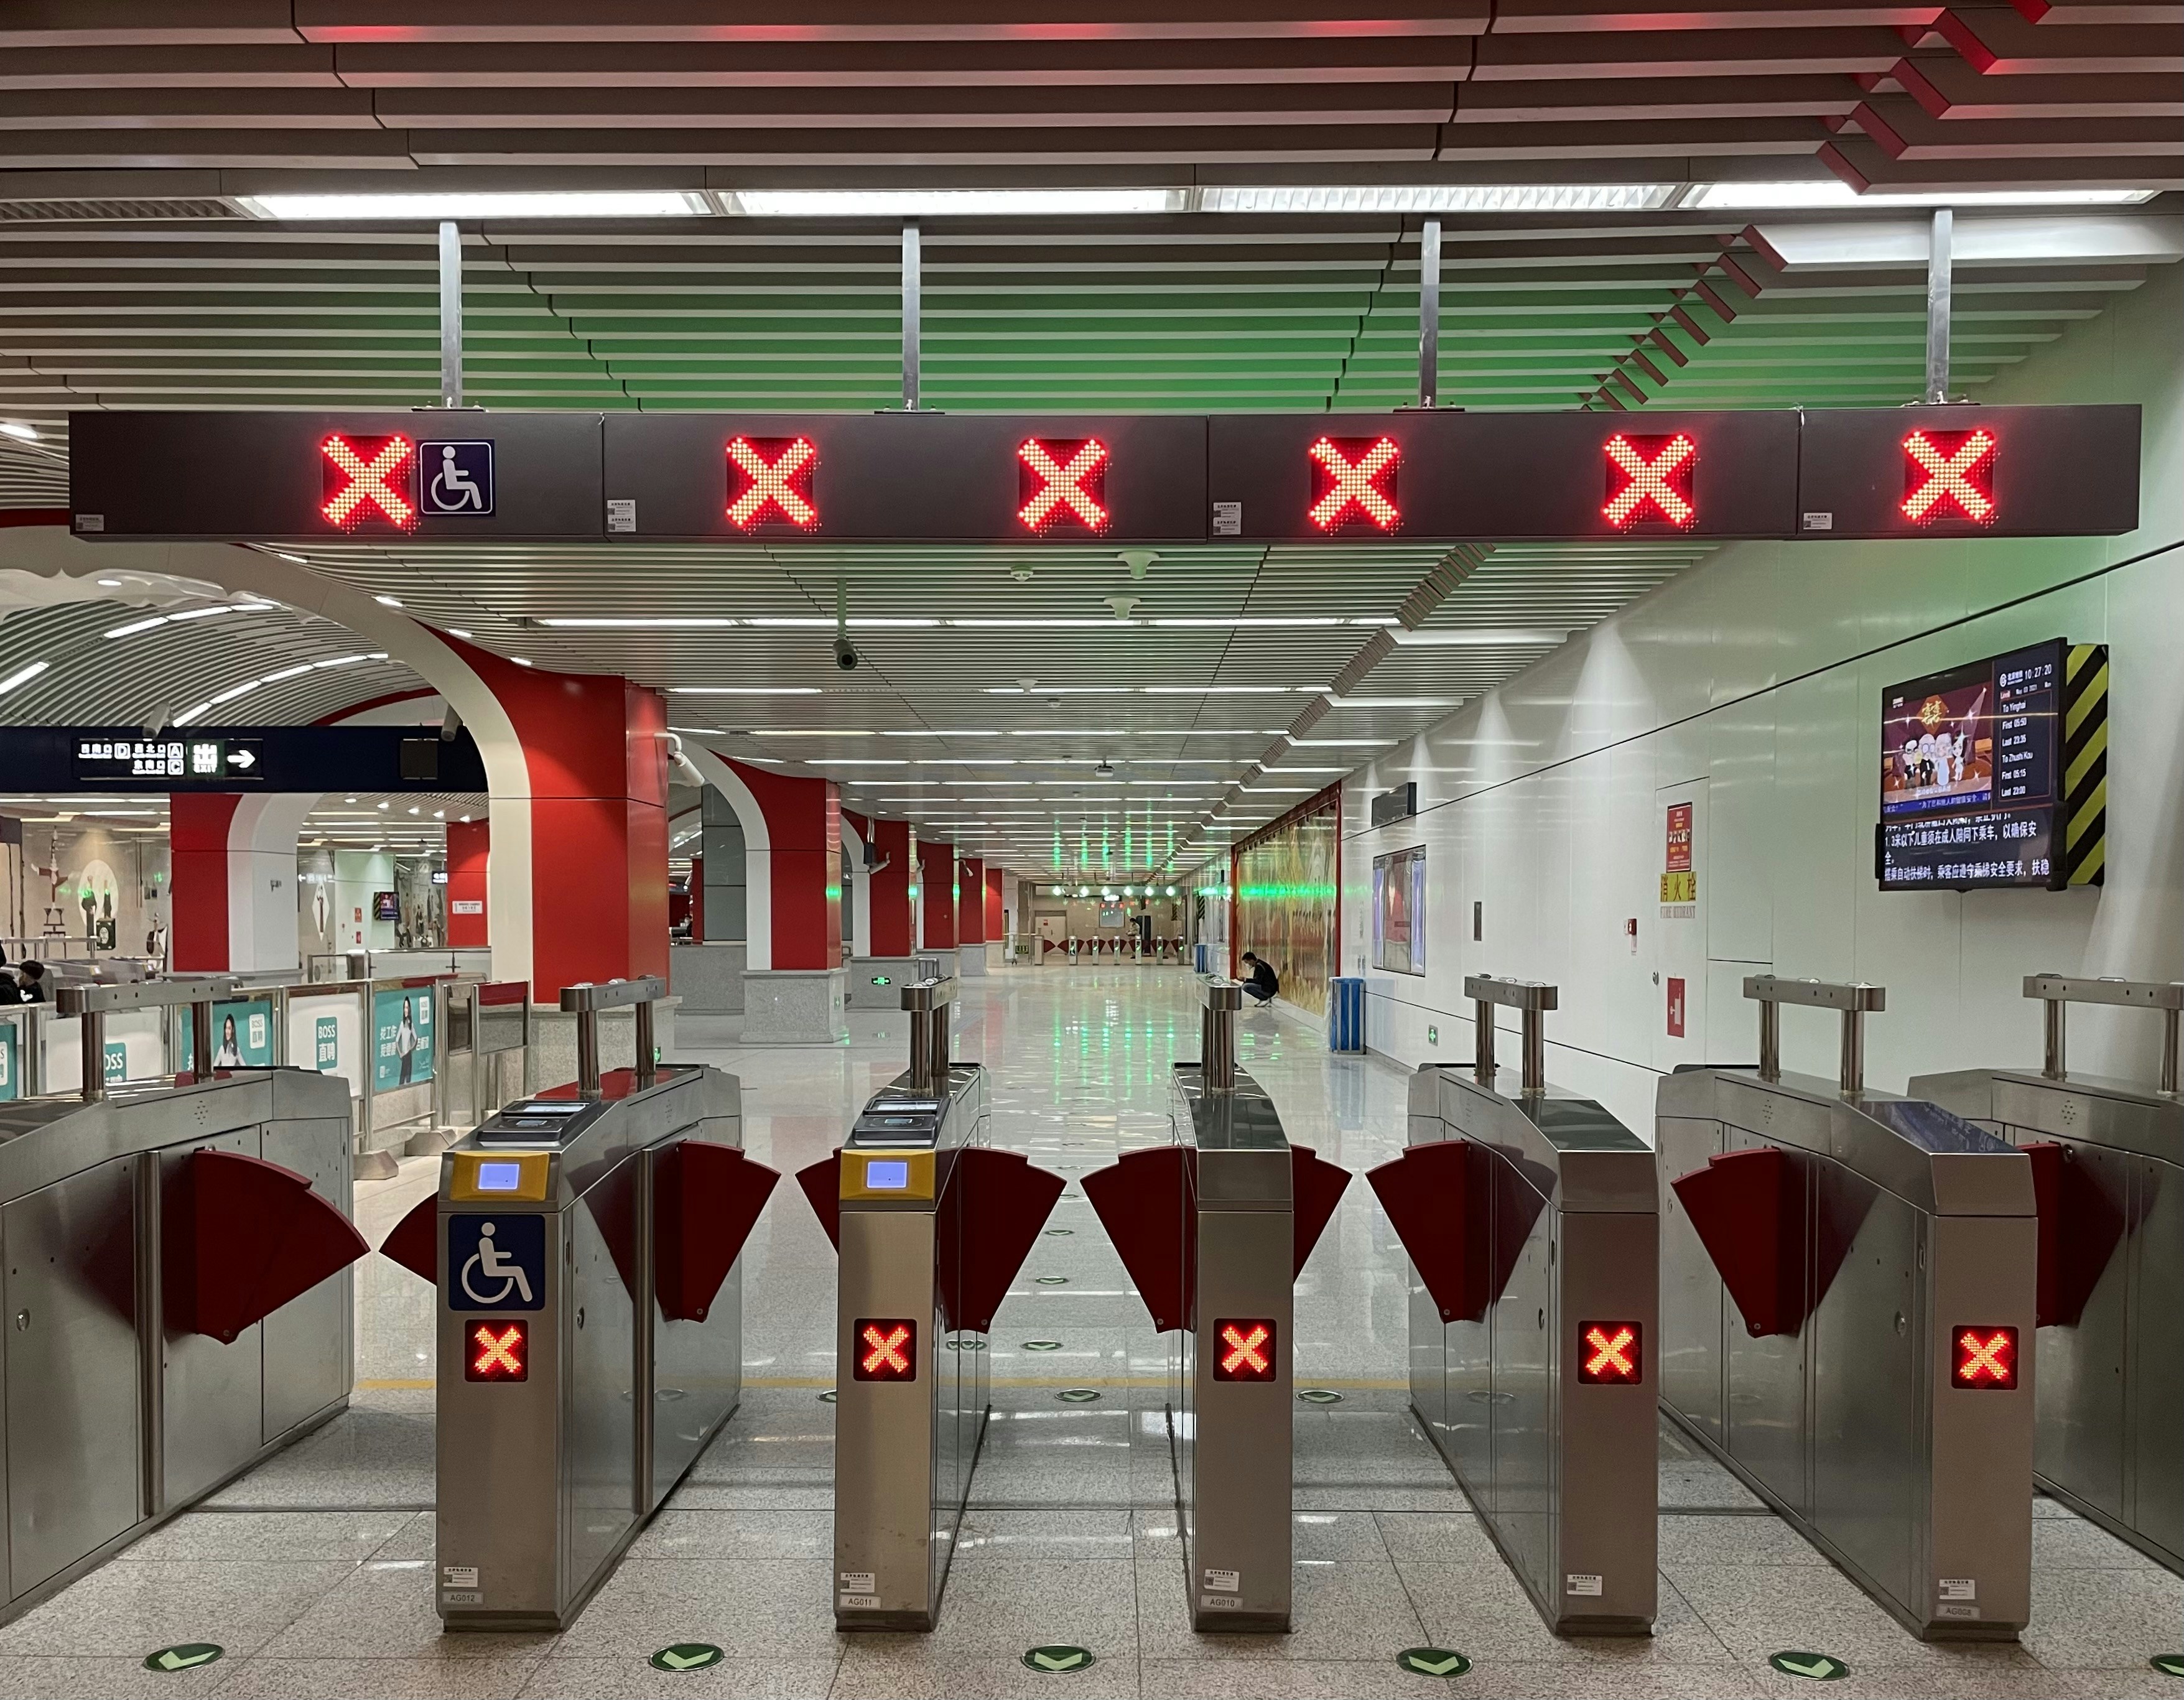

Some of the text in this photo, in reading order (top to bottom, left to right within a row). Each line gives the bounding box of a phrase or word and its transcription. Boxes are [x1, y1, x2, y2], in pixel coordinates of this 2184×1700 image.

[2025, 664, 2052, 680] 10:27:20
[2002, 704, 2009, 713] To
[318, 1024, 336, 1039] BOSS
[318, 1041, 336, 1062] 直聘
[105, 1052, 123, 1071] OSS
[450, 1594, 475, 1602] AG012
[848, 1598, 871, 1607] AG011
[1210, 1598, 1235, 1607] AG010
